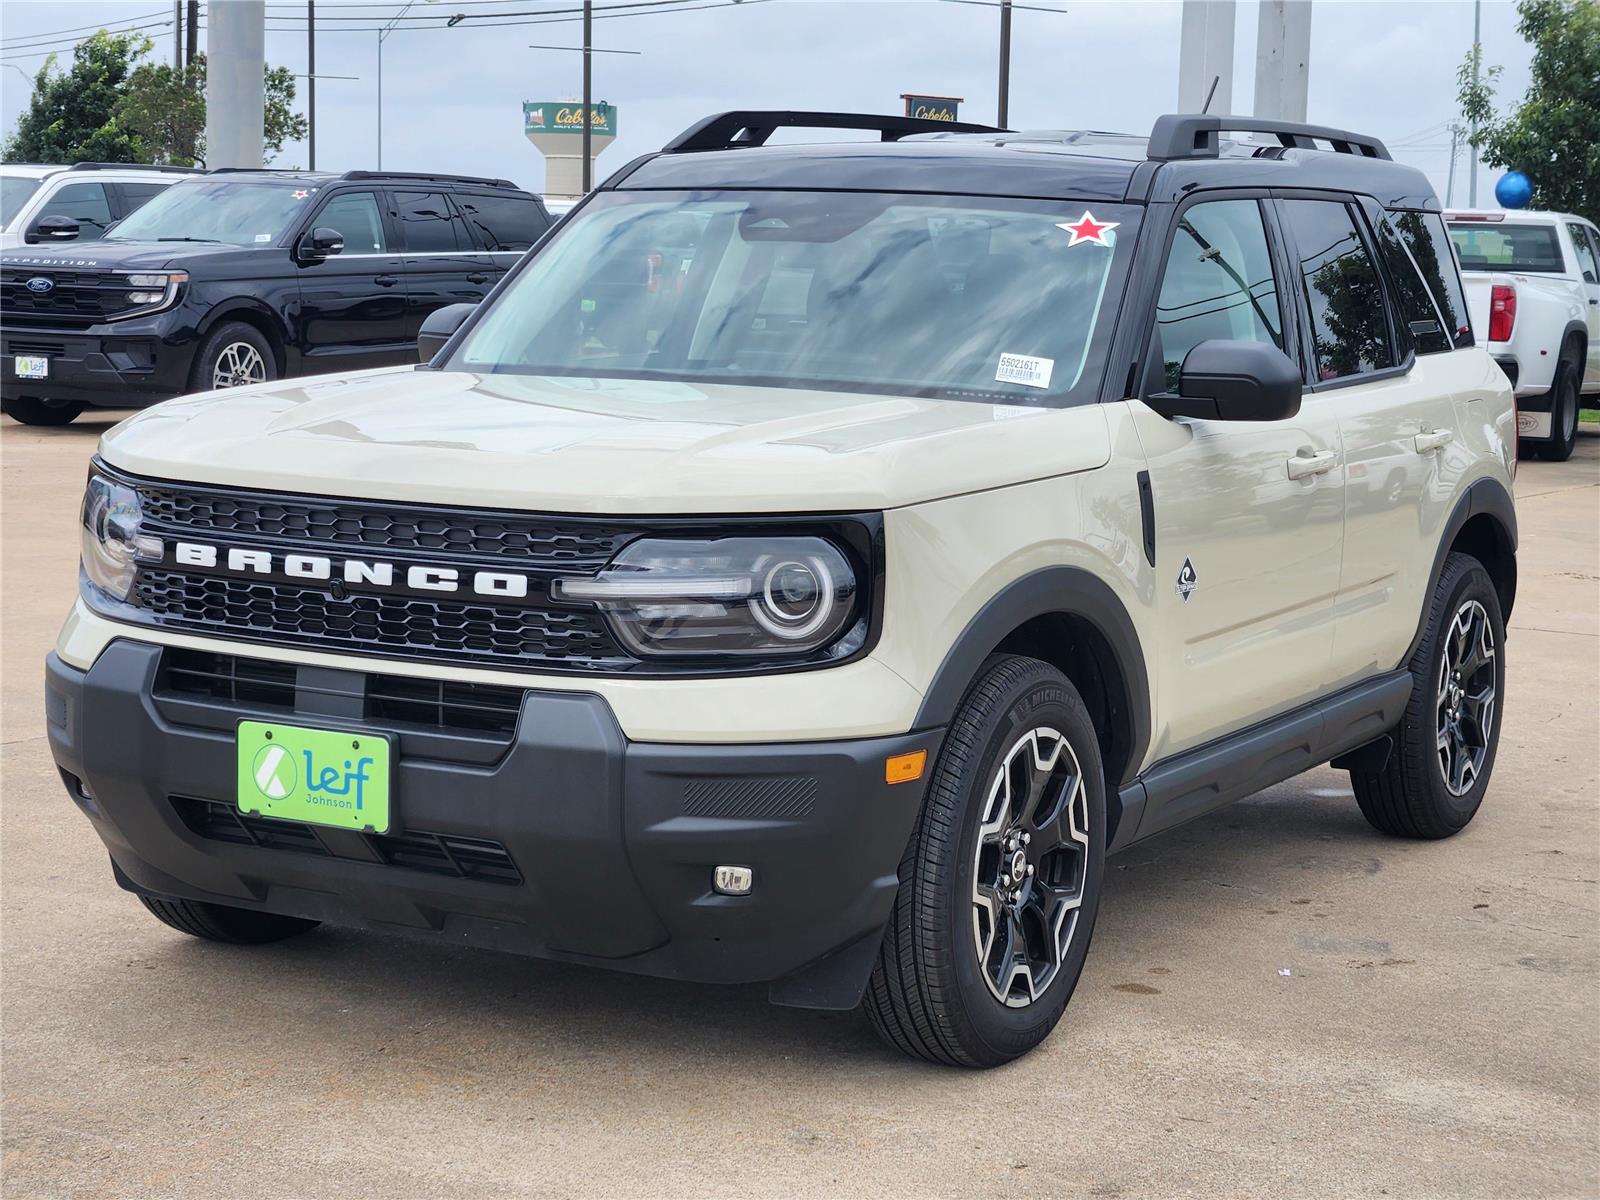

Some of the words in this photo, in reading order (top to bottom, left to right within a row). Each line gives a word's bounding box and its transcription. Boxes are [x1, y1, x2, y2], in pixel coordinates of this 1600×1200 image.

[915, 105, 954, 122] Cabela's
[2, 257, 97, 266] EXPEDITION
[31, 280, 48, 290] Ford
[1001, 357, 1039, 371] 5502161T
[175, 542, 528, 598] BRONCO
[305, 793, 352, 809] Johnson
